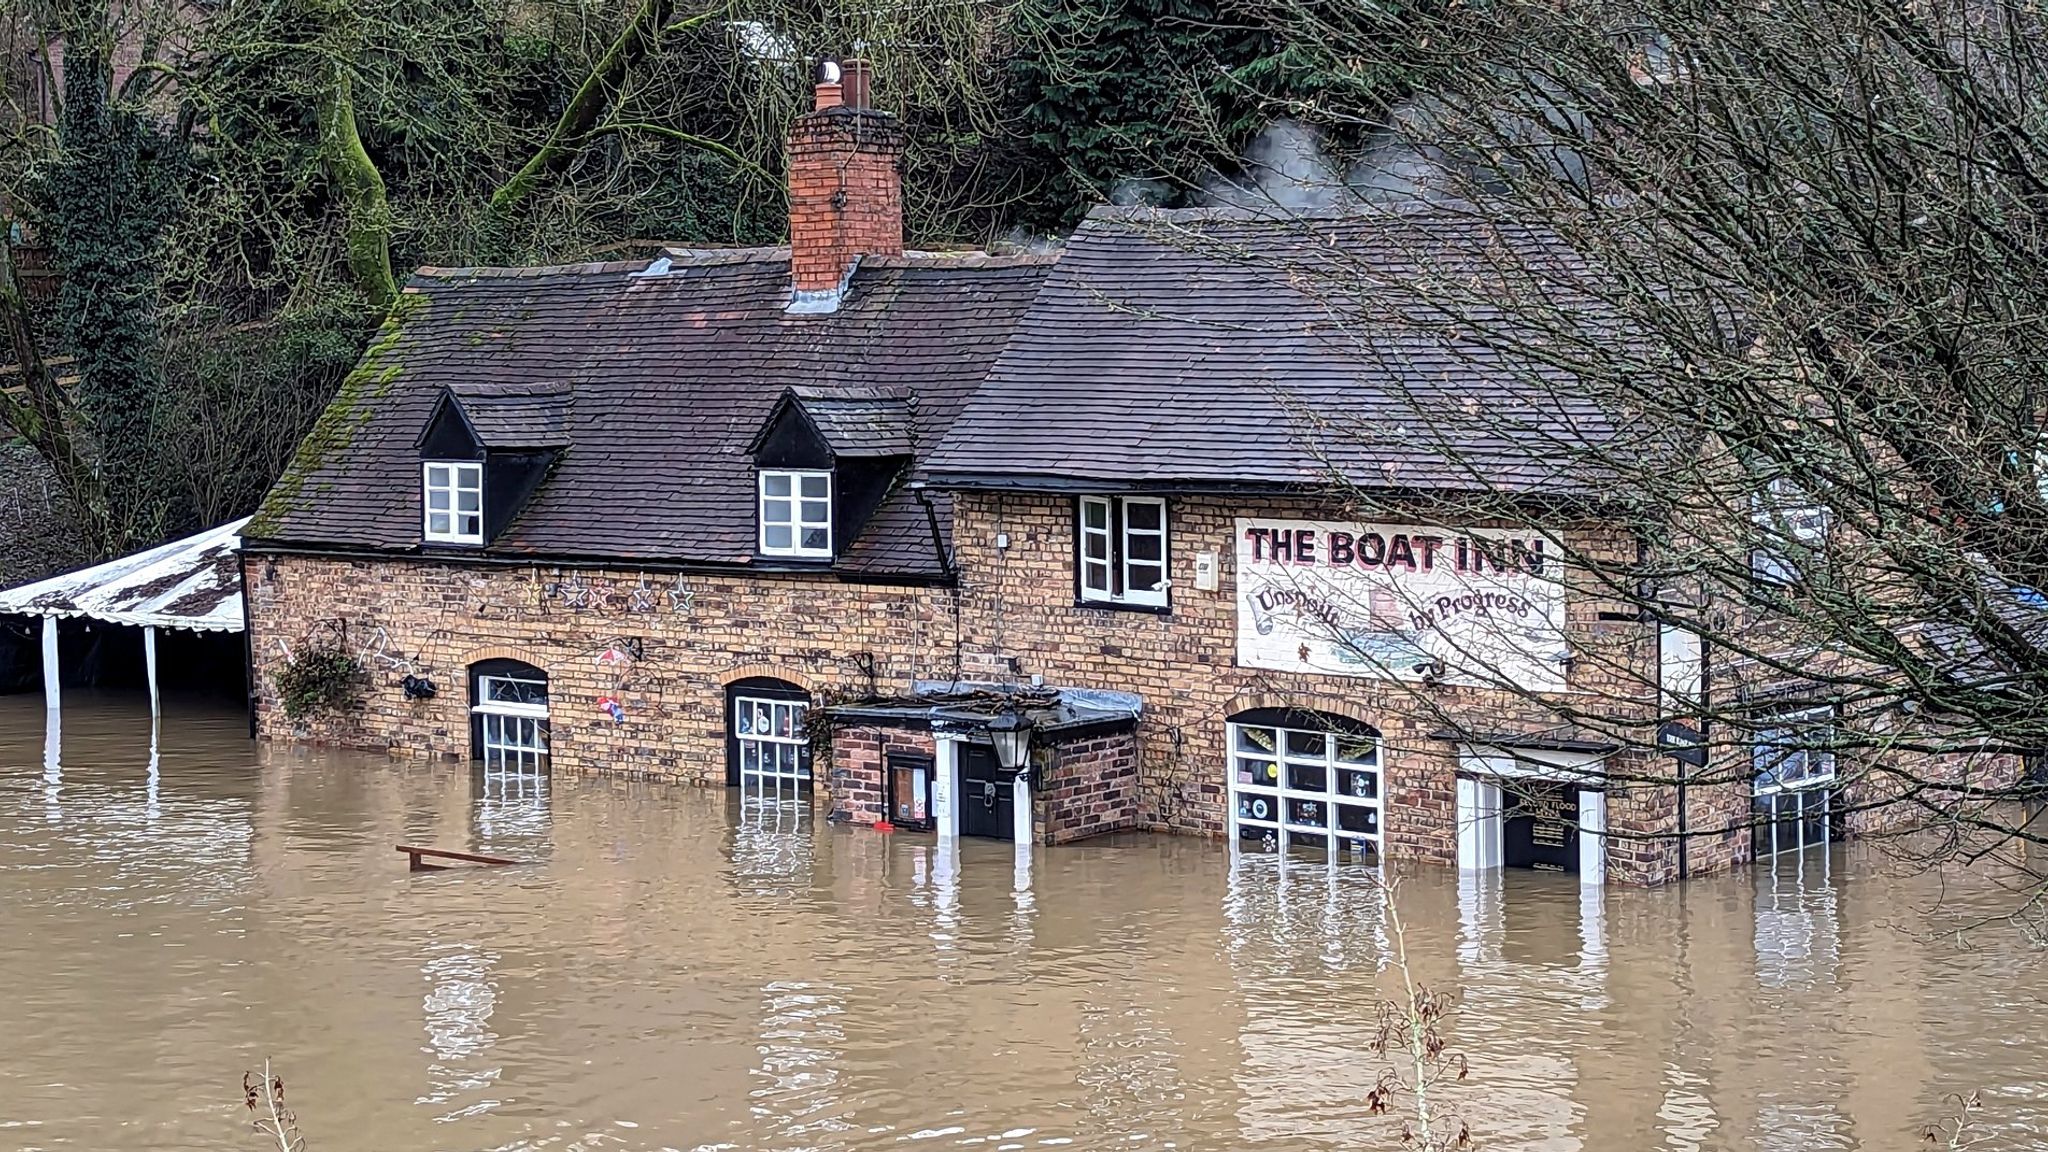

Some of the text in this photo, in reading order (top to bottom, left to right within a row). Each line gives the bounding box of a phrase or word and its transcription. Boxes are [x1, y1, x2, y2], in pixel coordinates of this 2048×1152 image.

[1245, 527, 1544, 576] THE BOAT INN
[1435, 589, 1531, 620] Progress
